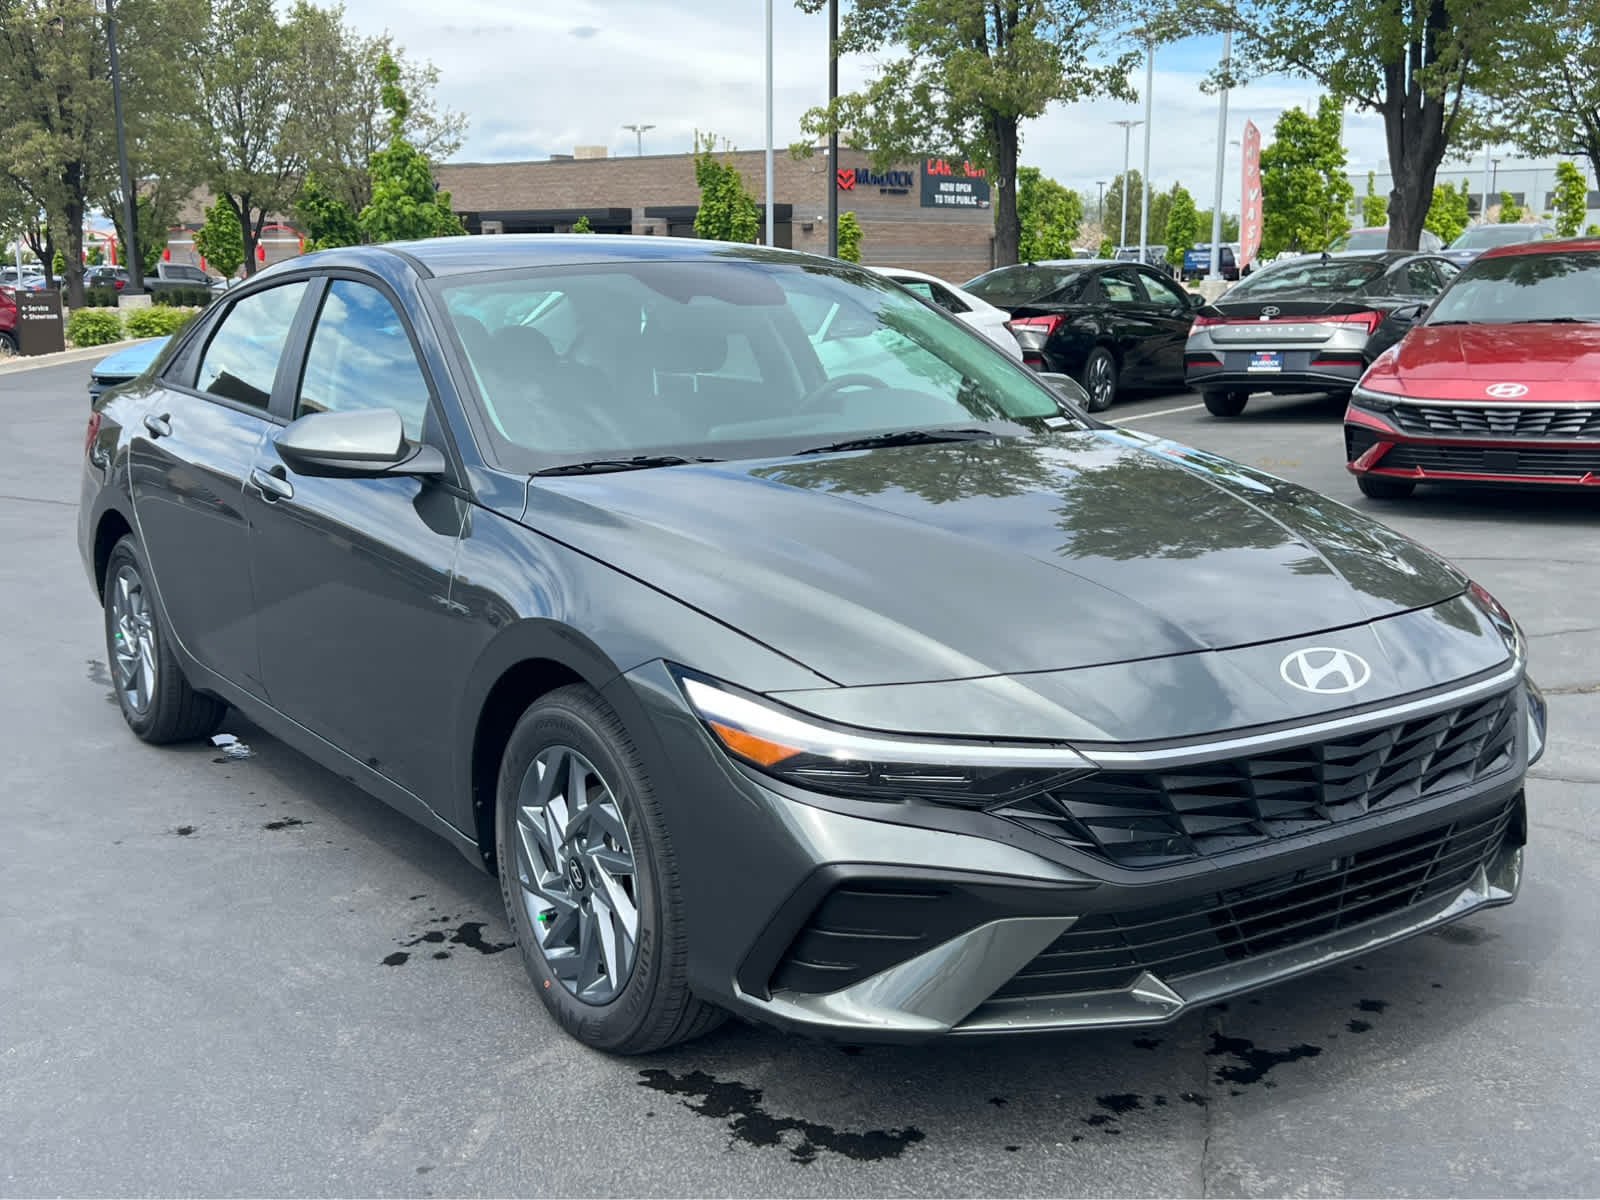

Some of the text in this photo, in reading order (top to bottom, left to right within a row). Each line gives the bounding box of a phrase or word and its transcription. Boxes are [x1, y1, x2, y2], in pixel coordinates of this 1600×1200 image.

[940, 182, 972, 193] NOW OPEN
[934, 194, 943, 204] TO
[944, 195, 955, 204] THE
[956, 195, 977, 205] PUBLIC
